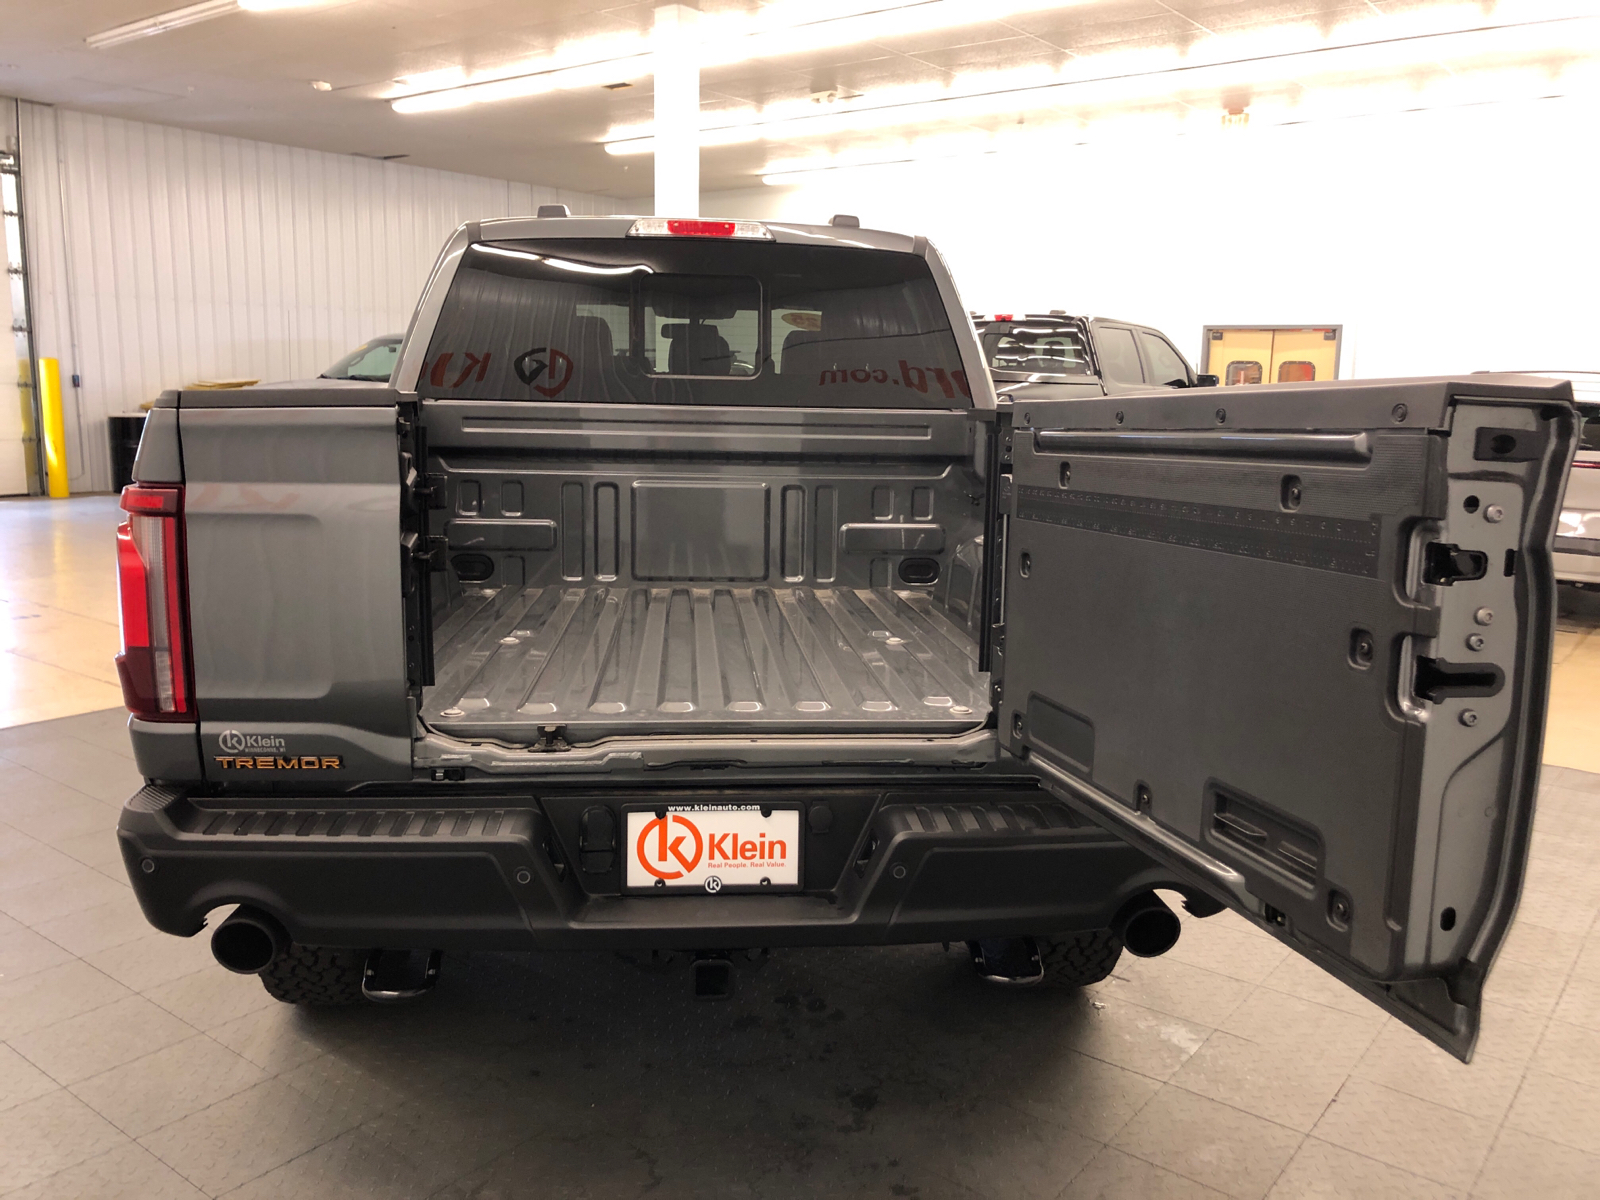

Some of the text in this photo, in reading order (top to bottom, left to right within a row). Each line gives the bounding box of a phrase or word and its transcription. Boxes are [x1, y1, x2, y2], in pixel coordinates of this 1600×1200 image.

[246, 735, 285, 747] Klein
[213, 755, 341, 769] TREMOR
[708, 832, 787, 861] Klein
[724, 862, 749, 870] People.
